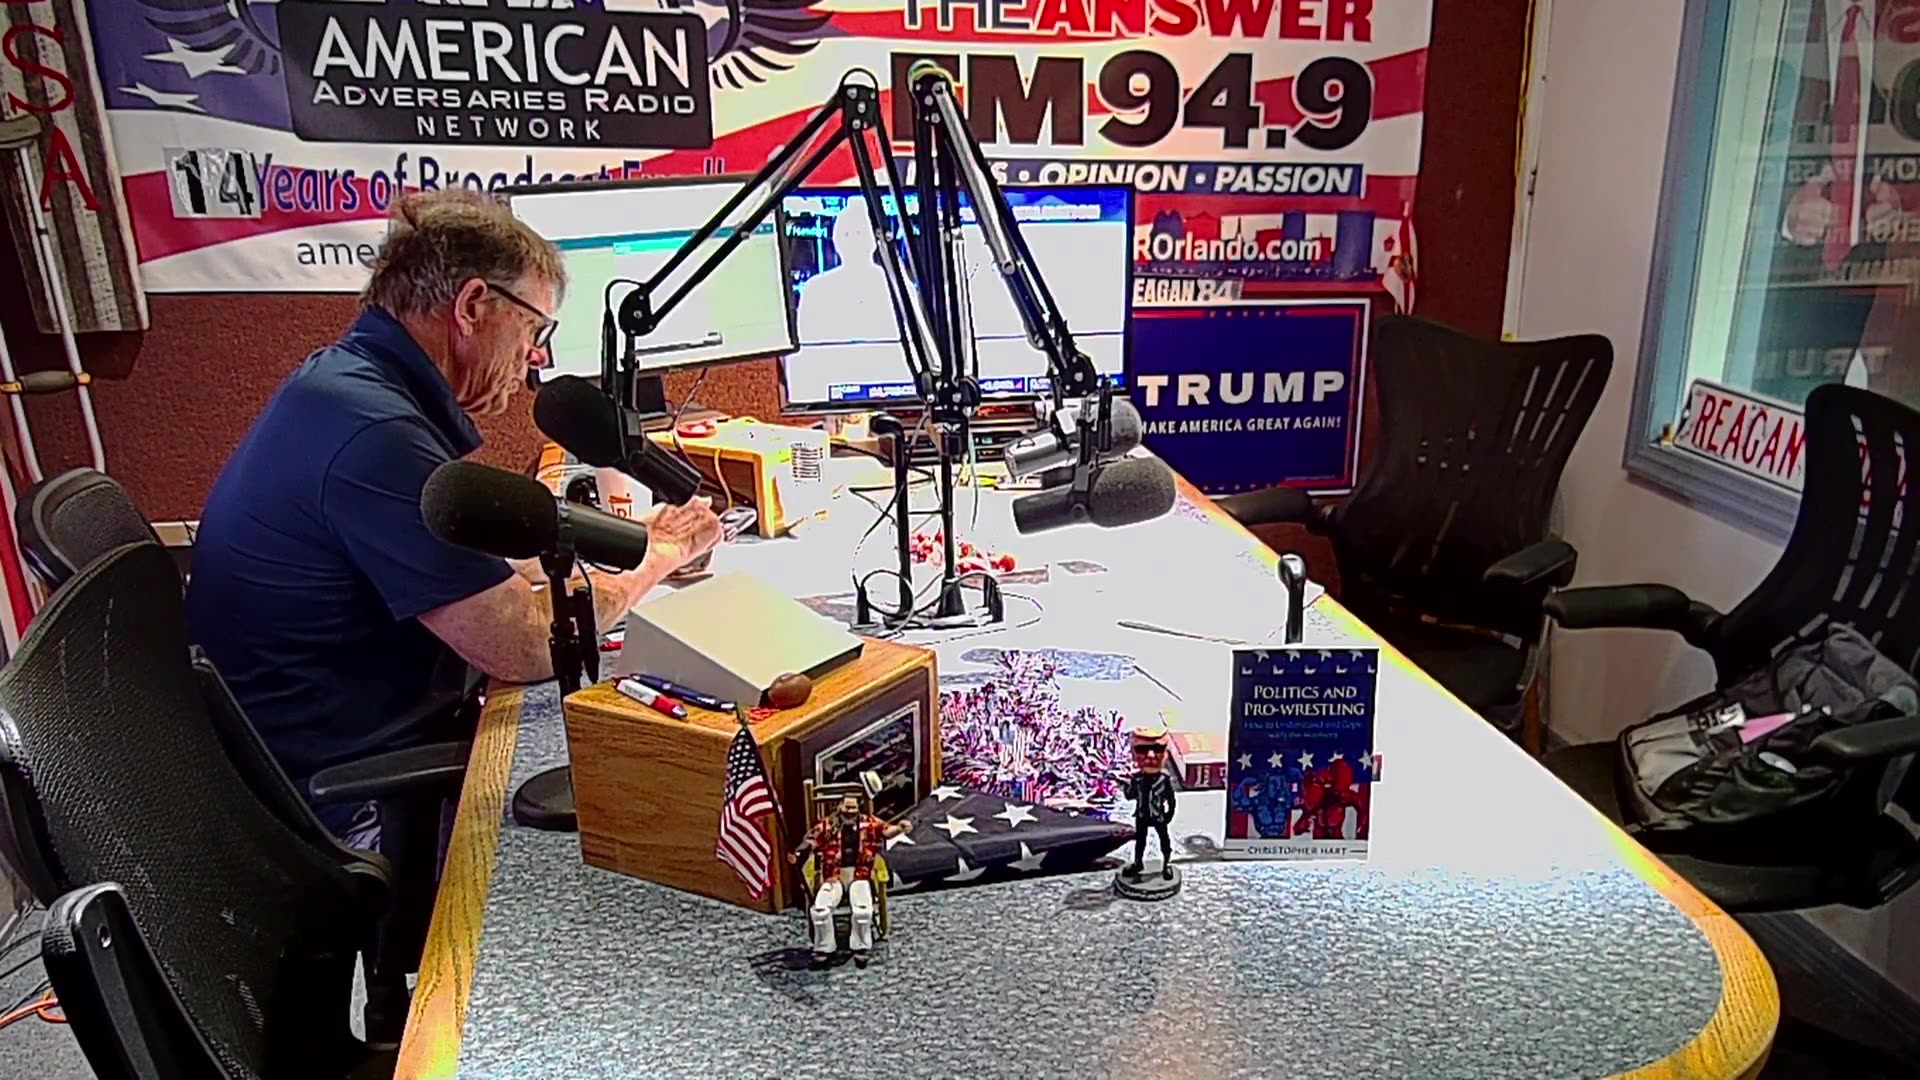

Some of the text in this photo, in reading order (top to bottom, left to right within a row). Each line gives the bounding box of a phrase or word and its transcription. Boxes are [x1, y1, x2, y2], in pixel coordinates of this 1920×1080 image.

[312, 16, 690, 88] AMERICAN
[2, 0, 102, 212] SA
[312, 80, 696, 115] ADVERSARIES RADIO
[1098, 49, 1372, 151] 94.9
[416, 115, 601, 140] NETWORK
[175, 150, 255, 216] 14
[250, 152, 360, 213] Years
[368, 151, 410, 212] of
[1038, 162, 1189, 192] OPINION
[1213, 164, 1354, 194] PASSION
[1132, 231, 1323, 262] ROrlando.com
[1132, 278, 1196, 304] EAGAN
[1137, 371, 1346, 407] TRUMP
[1179, 418, 1243, 434] AMERICA
[1246, 416, 1291, 432] GREAT
[1293, 415, 1342, 430] AGAIN!
[1690, 393, 1808, 480] REAGAN
[1253, 685, 1358, 700] POLITICS AND
[1243, 702, 1366, 717] PRO-WRESTLING
[1247, 846, 1348, 856] CHRISTOPHER HART
